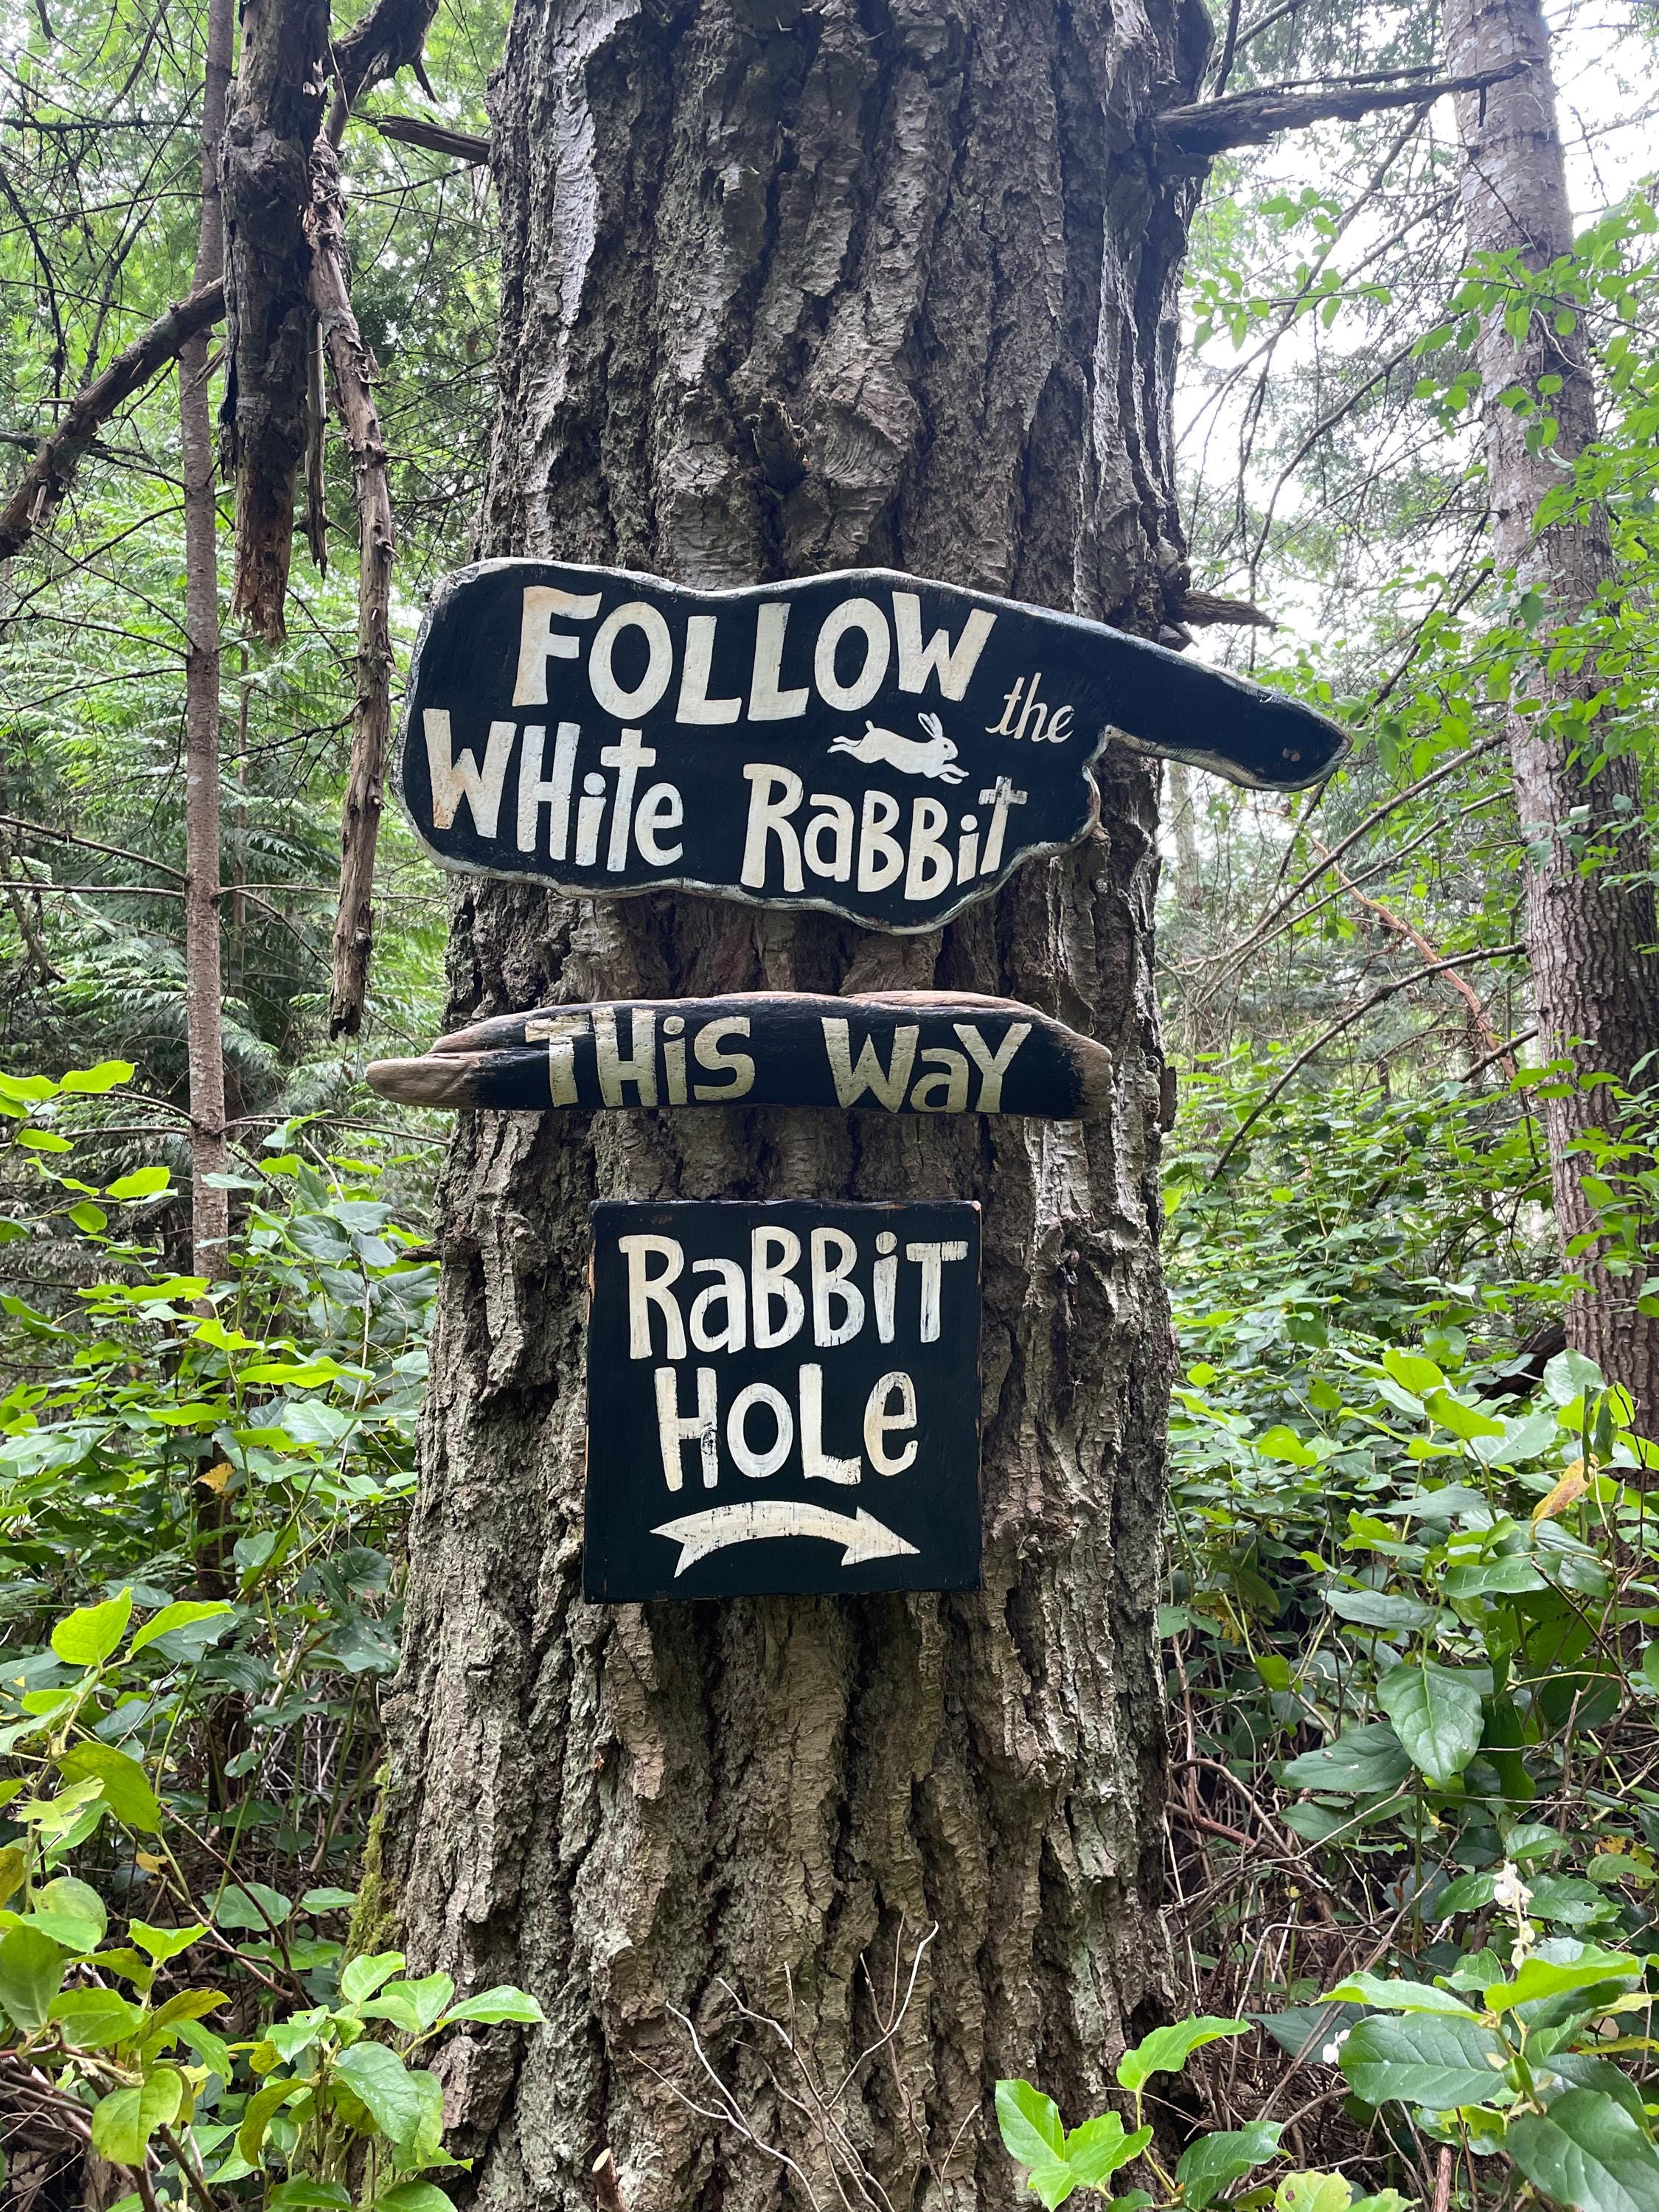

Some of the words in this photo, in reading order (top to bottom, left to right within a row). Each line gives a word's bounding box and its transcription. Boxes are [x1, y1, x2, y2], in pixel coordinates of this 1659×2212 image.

[512, 585, 997, 724] FOLLOW
[986, 672, 1073, 743] the
[525, 1006, 756, 1108] THiS
[821, 1017, 1032, 1114] WaY
[654, 1363, 919, 1492] HOLe
